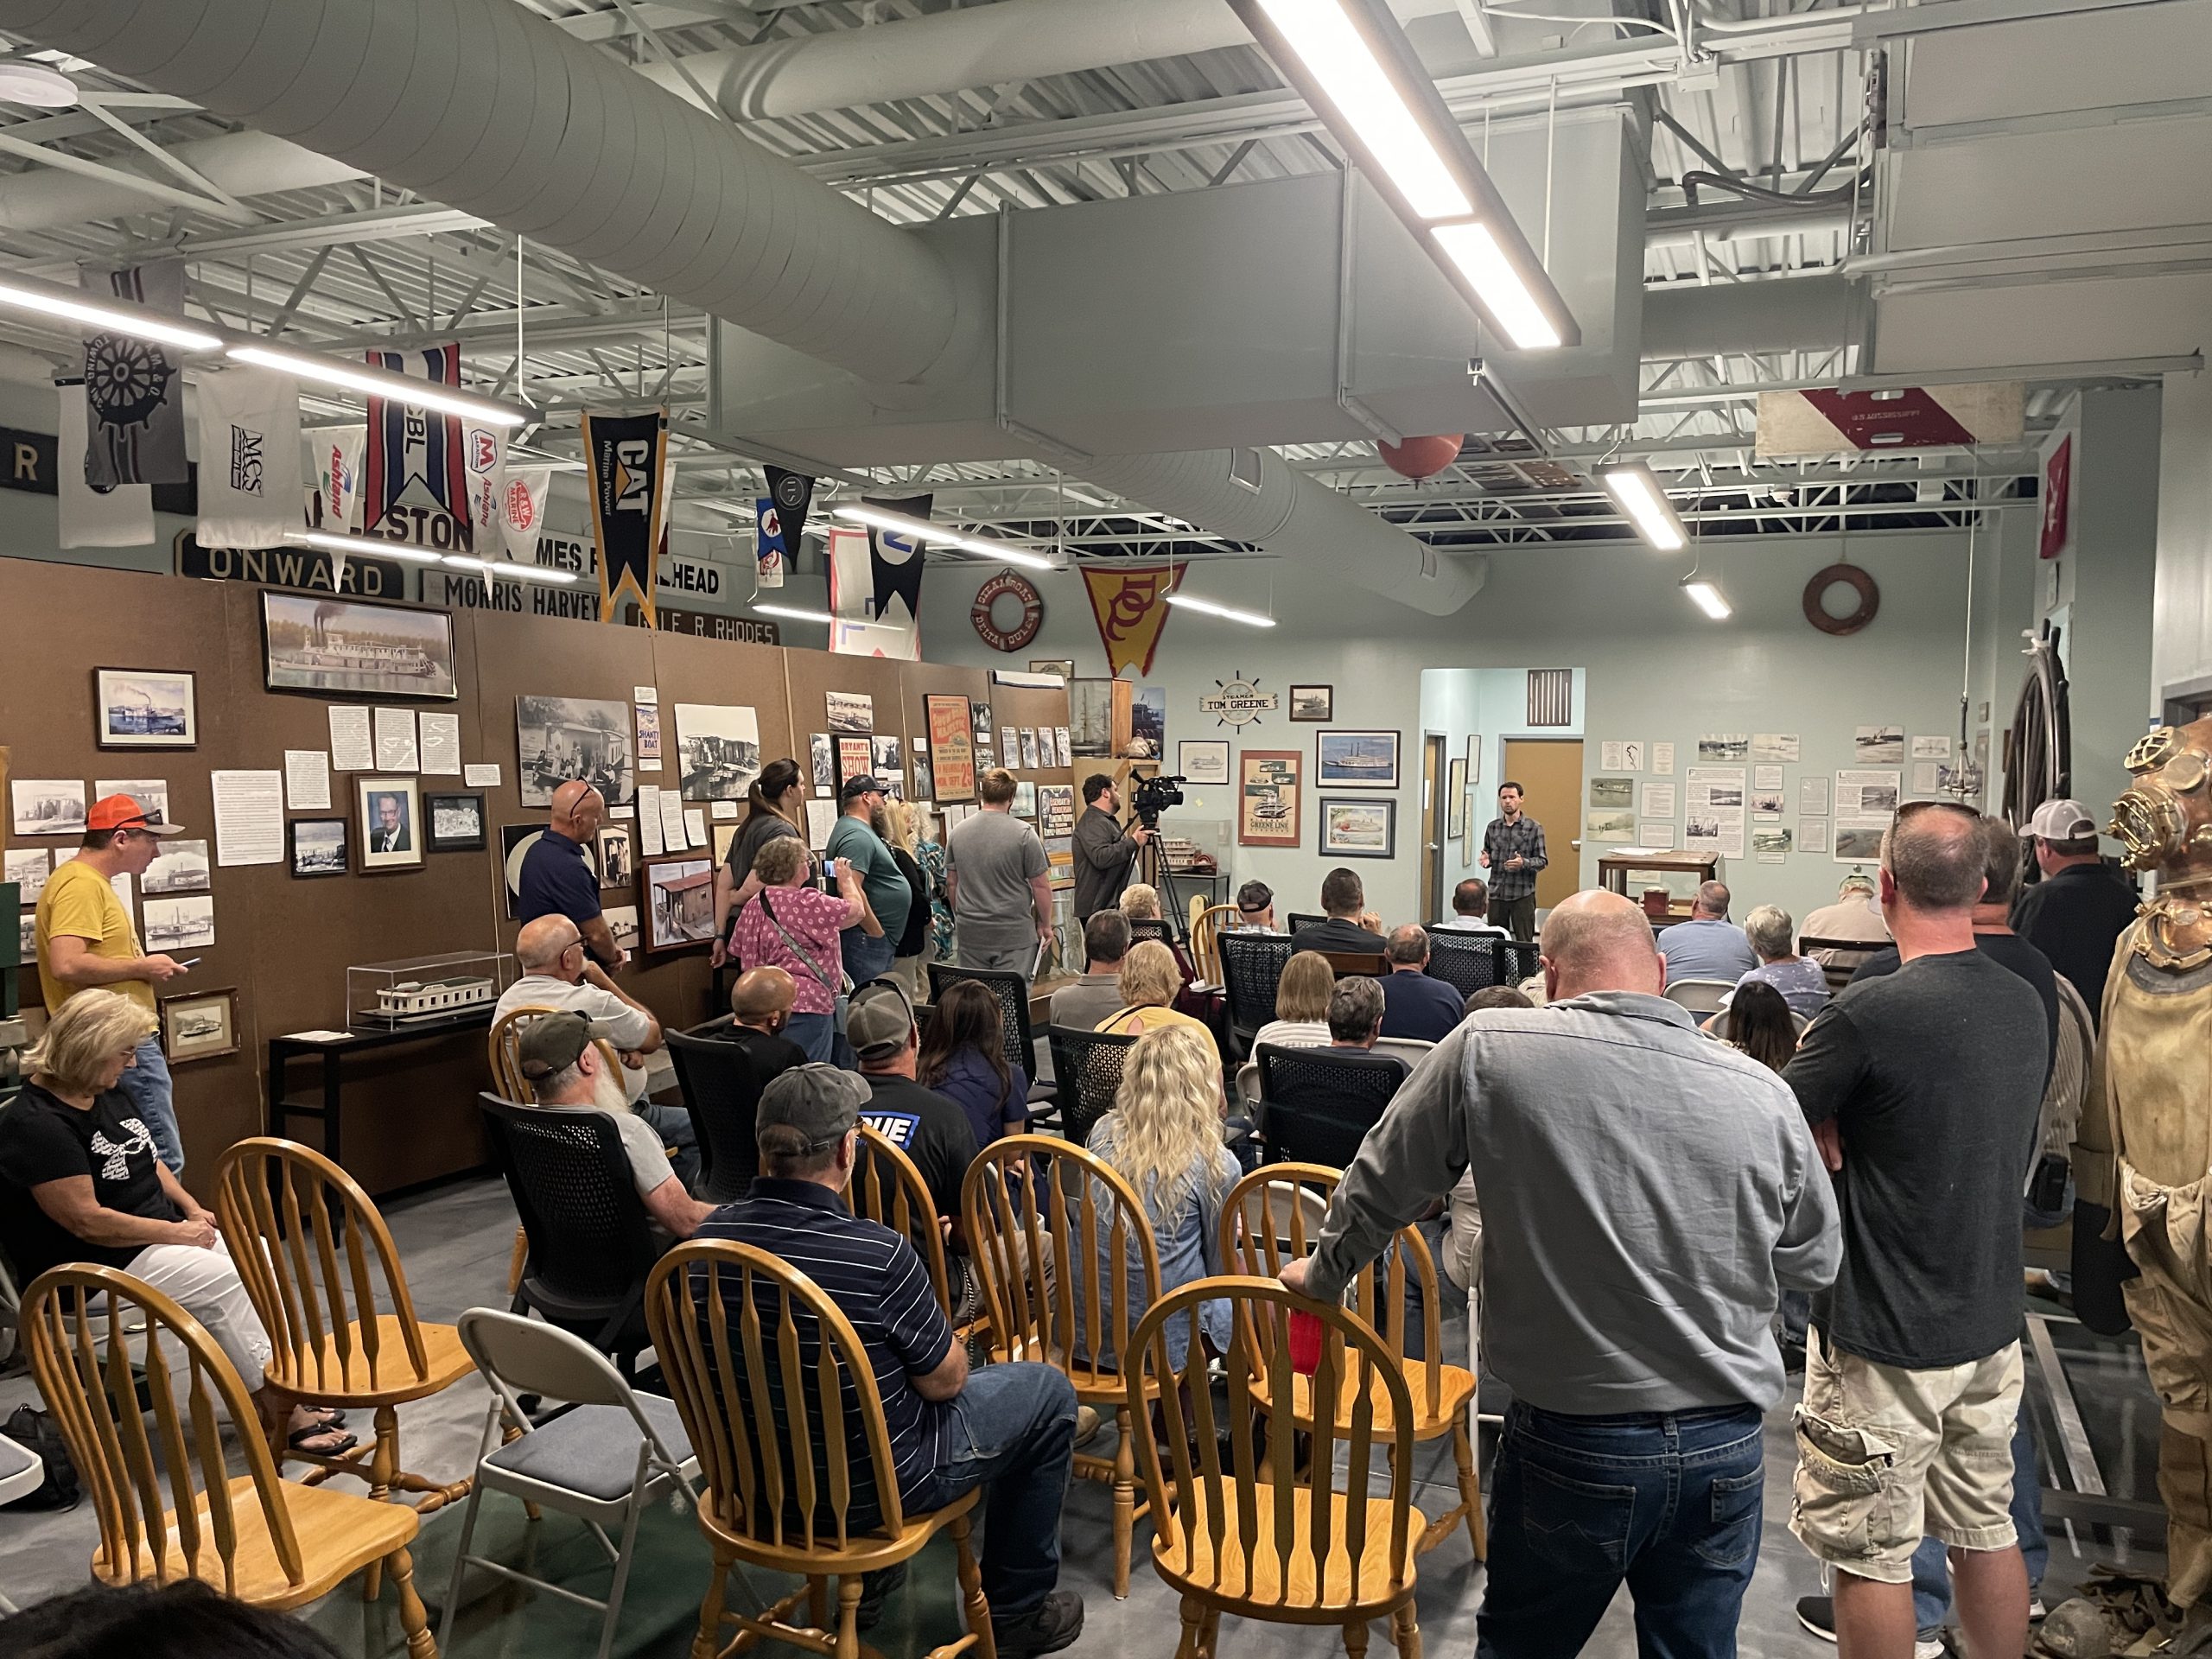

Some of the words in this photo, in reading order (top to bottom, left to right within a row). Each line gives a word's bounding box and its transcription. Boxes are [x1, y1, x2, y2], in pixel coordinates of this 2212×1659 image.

[13, 442, 38, 481] R
[602, 440, 613, 479] Marine
[331, 443, 344, 520] Ashland
[616, 439, 649, 516] CAT
[480, 476, 493, 528] Ashland
[511, 486, 519, 524] MARINE
[209, 548, 382, 595] ONWARD
[536, 537, 582, 572] MES
[655, 563, 719, 594] HEAD
[445, 575, 523, 613] MORRIS
[533, 587, 601, 622] HARVEY
[715, 618, 773, 646] RHODES
[976, 615, 1000, 645] DELTA
[1207, 701, 1226, 709] TOM
[1230, 700, 1268, 709] GREENE
[639, 730, 659, 740] SHANTY
[644, 740, 658, 749] BOAT
[841, 742, 869, 752] BRYANT'S
[842, 756, 869, 777] SHOW
